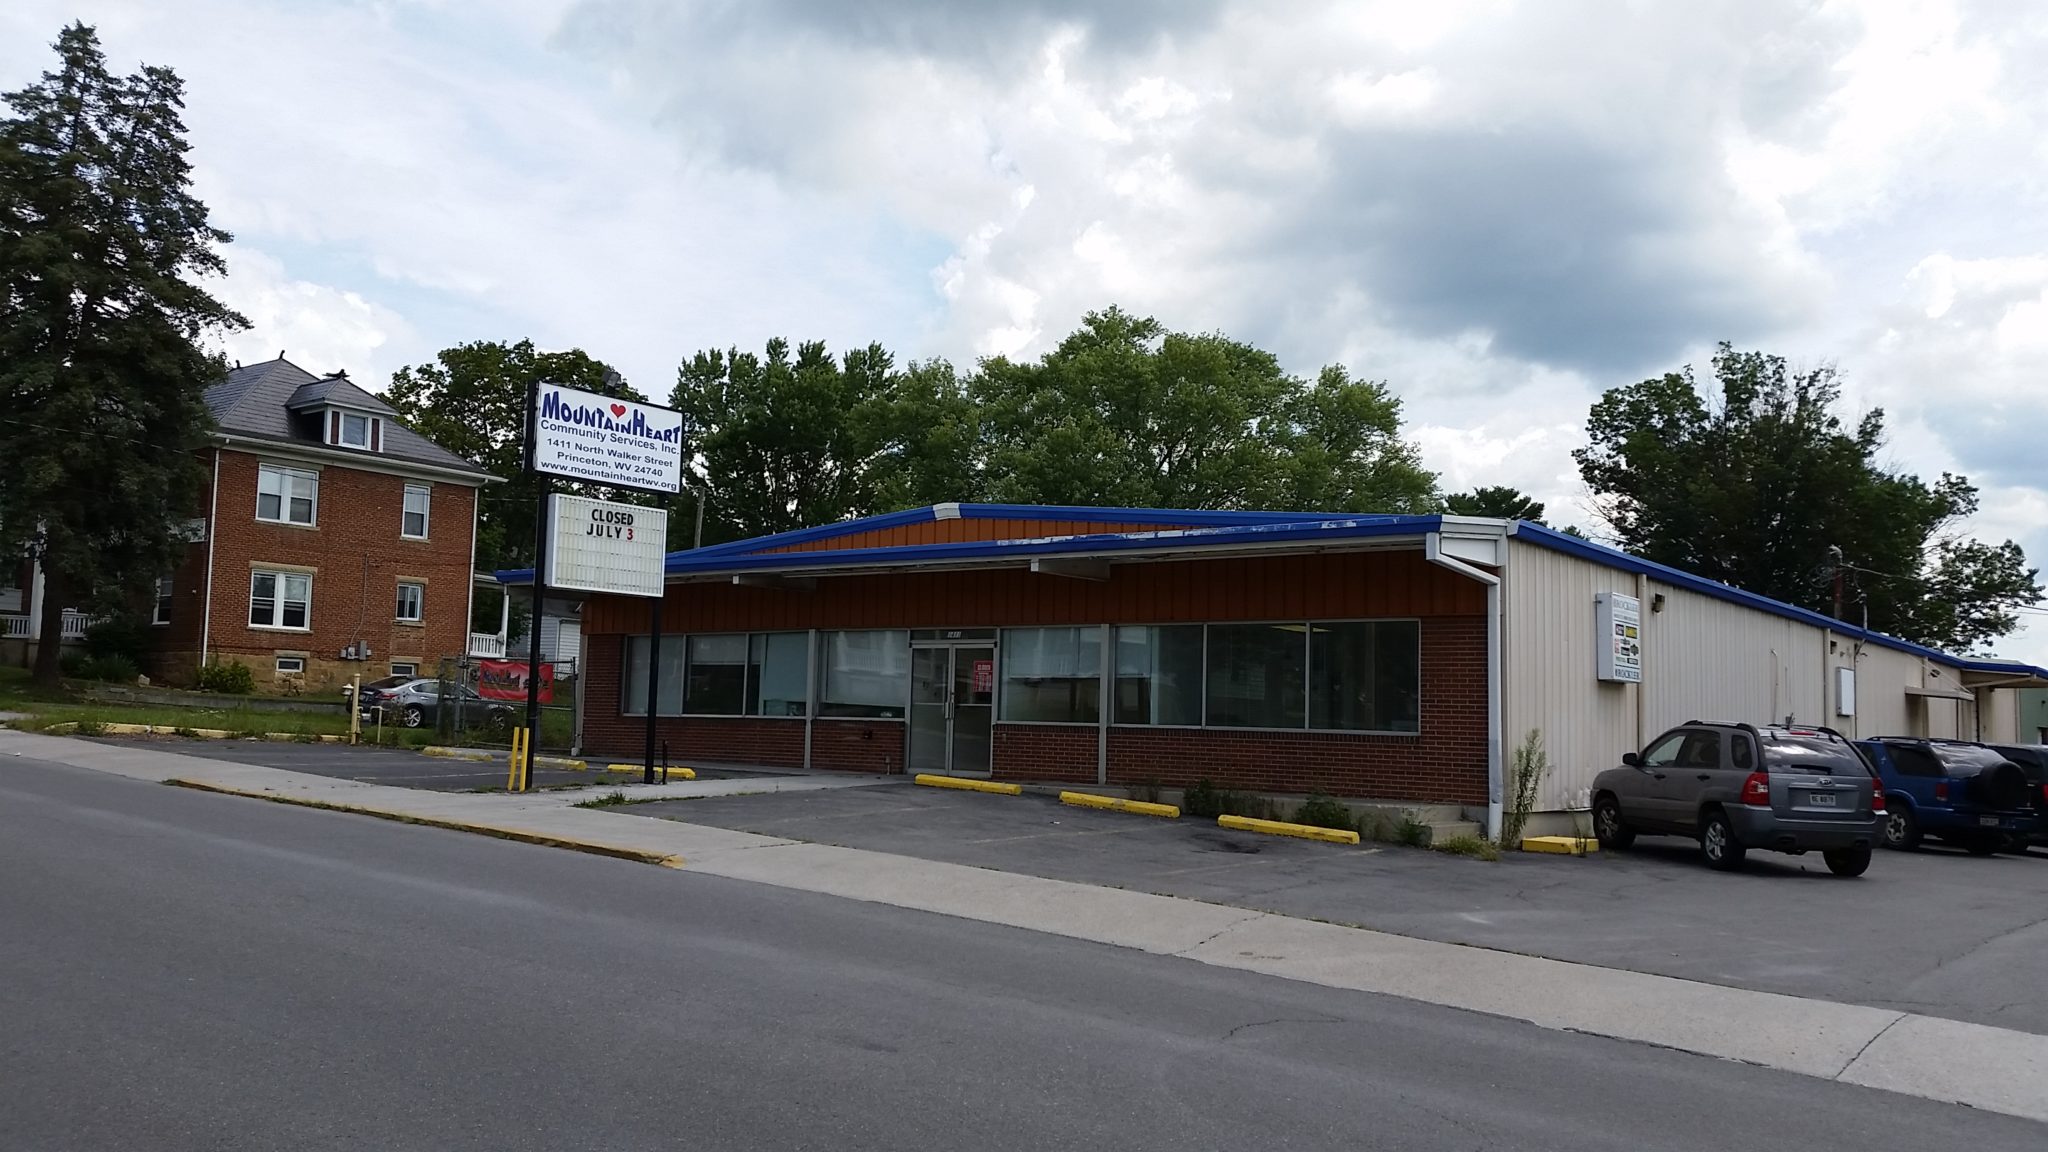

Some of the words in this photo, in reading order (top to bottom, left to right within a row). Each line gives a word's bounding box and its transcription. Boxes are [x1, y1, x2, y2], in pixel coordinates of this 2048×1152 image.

[540, 419, 607, 443] Community
[609, 432, 658, 452] Services,
[661, 442, 680, 455] Inc.
[547, 438, 571, 449] 1411
[574, 442, 604, 455] North
[607, 448, 642, 462] Walker
[644, 455, 673, 468] Street
[557, 451, 612, 469] Princeton,
[614, 461, 632, 472] WV
[634, 464, 663, 477] 24740
[540, 461, 677, 492] www.mountainheartwv.org
[591, 508, 634, 526] CLOSED
[586, 523, 622, 539] JULY
[626, 528, 634, 541] 3
